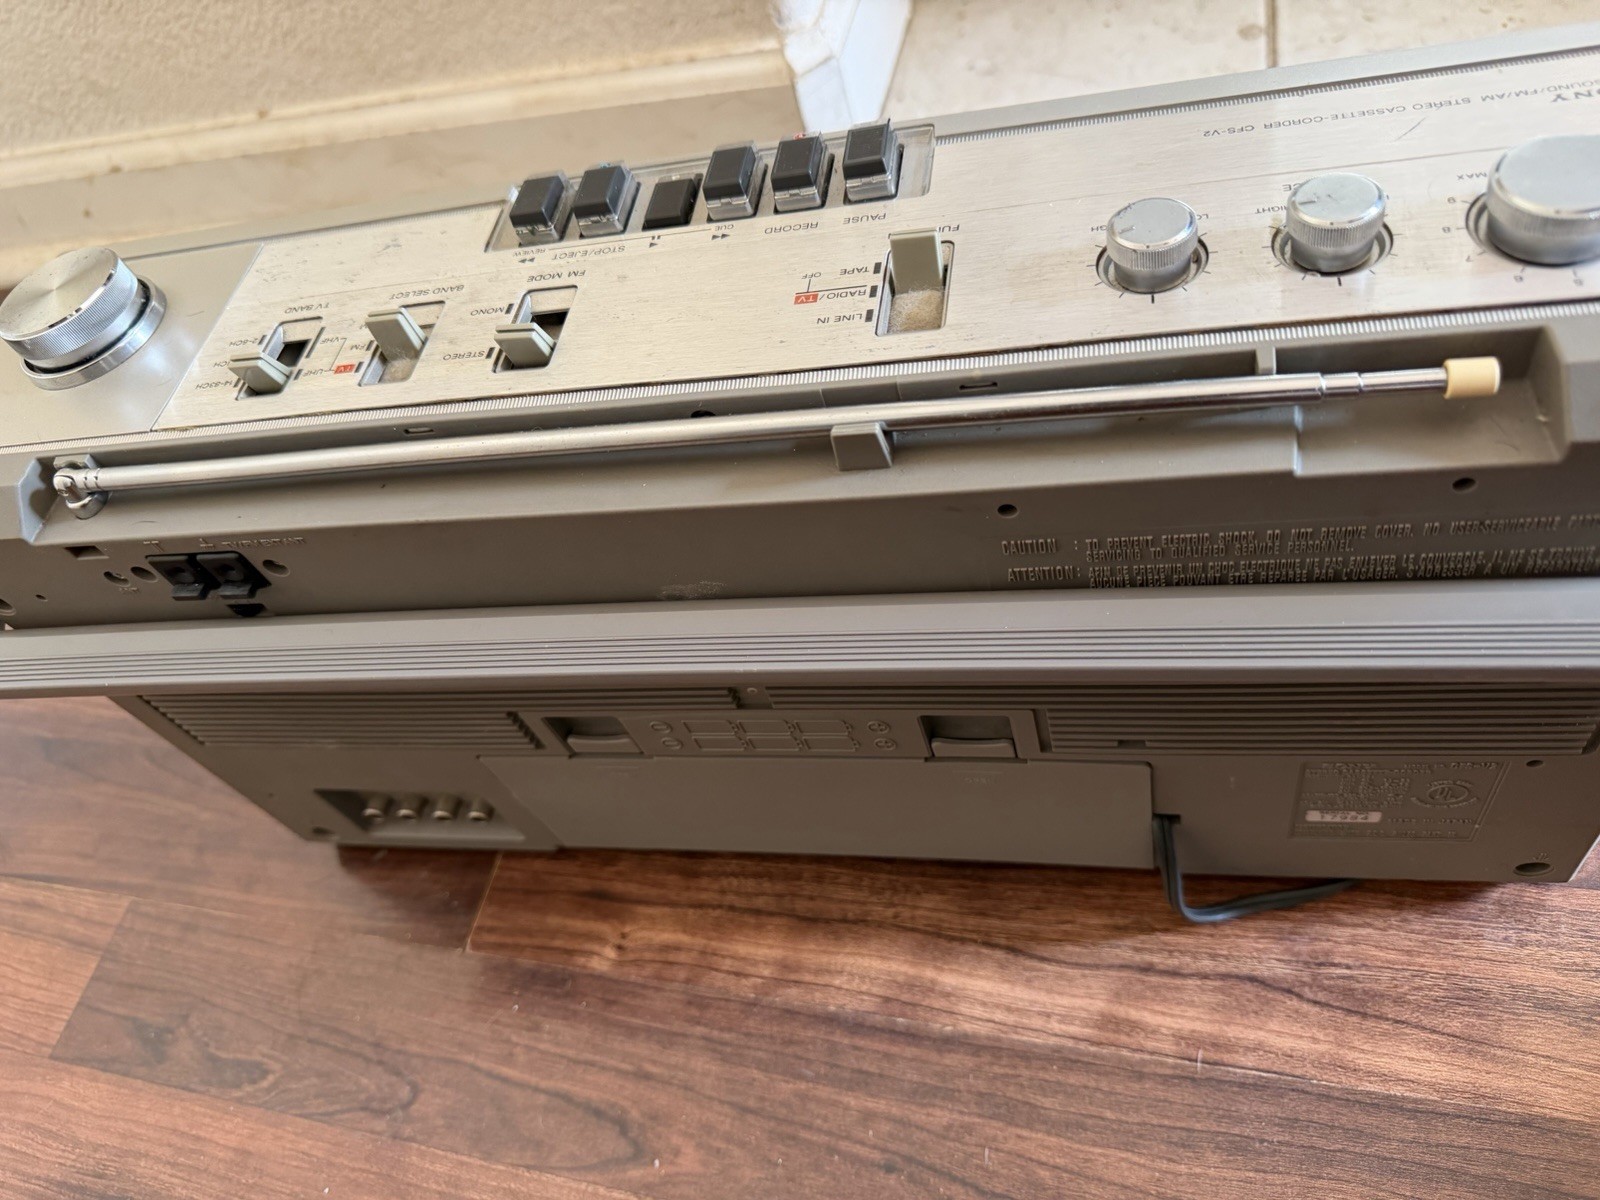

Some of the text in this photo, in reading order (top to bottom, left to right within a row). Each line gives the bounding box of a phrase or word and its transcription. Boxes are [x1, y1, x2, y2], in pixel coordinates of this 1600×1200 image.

[1413, 97, 1470, 110] STEREO
[1264, 106, 1406, 130] CASSETTE-CORDER
[1203, 124, 1255, 138] CFS-V2
[1457, 172, 1487, 180] MAX
[844, 212, 886, 224] PAUSE
[764, 222, 818, 234] RECORD
[513, 248, 546, 257] REVIEW
[552, 245, 626, 260] STOP/EJECT
[526, 270, 586, 283] FM MODE
[802, 272, 822, 280] OFF
[839, 266, 870, 276] TAPE
[388, 284, 465, 300] BAND SELECT
[284, 304, 314, 314] BAND
[470, 306, 506, 316] MONO
[817, 313, 864, 324] LINE IN
[442, 350, 485, 362] STEREO
[1001, 538, 1057, 556] CAUTION
[1086, 538, 1099, 551] TO
[1106, 536, 1154, 550] PREVENT
[1161, 532, 1210, 548] ELECTRIC
[1266, 529, 1280, 543] DO
[1290, 528, 1313, 542] NOT
[1320, 525, 1367, 540] REMOVE
[1374, 523, 1414, 539] COVER.
[1423, 522, 1440, 536] NO
[1086, 539, 1354, 563] SERVICING TO QUALIFIED SERVICE PERSONNEL.
[1088, 566, 1110, 579] AFIN
[1116, 564, 1129, 578] DE
[1132, 562, 1182, 577] PREVENIR
[1188, 562, 1203, 576] UN
[1208, 561, 1234, 575] CHOC
[1240, 558, 1300, 574] ELECTRIQUE
[1305, 558, 1319, 572] NE
[1324, 557, 1343, 571] PAS
[1349, 554, 1396, 570] ENLEVER
[1402, 554, 1414, 568] LE
[1420, 551, 1486, 566] COUVERCLE.
[1090, 576, 1130, 588] AUCUNE
[1136, 576, 1166, 588] PIECE
[1173, 574, 1221, 587] POUVANT
[1228, 572, 1254, 584] ETRE
[1260, 570, 1307, 583] REPAREE
[1314, 569, 1334, 582] PAR
[1342, 566, 1398, 580] L'USAGER.
[1406, 564, 1476, 578] S'ADRESSER
